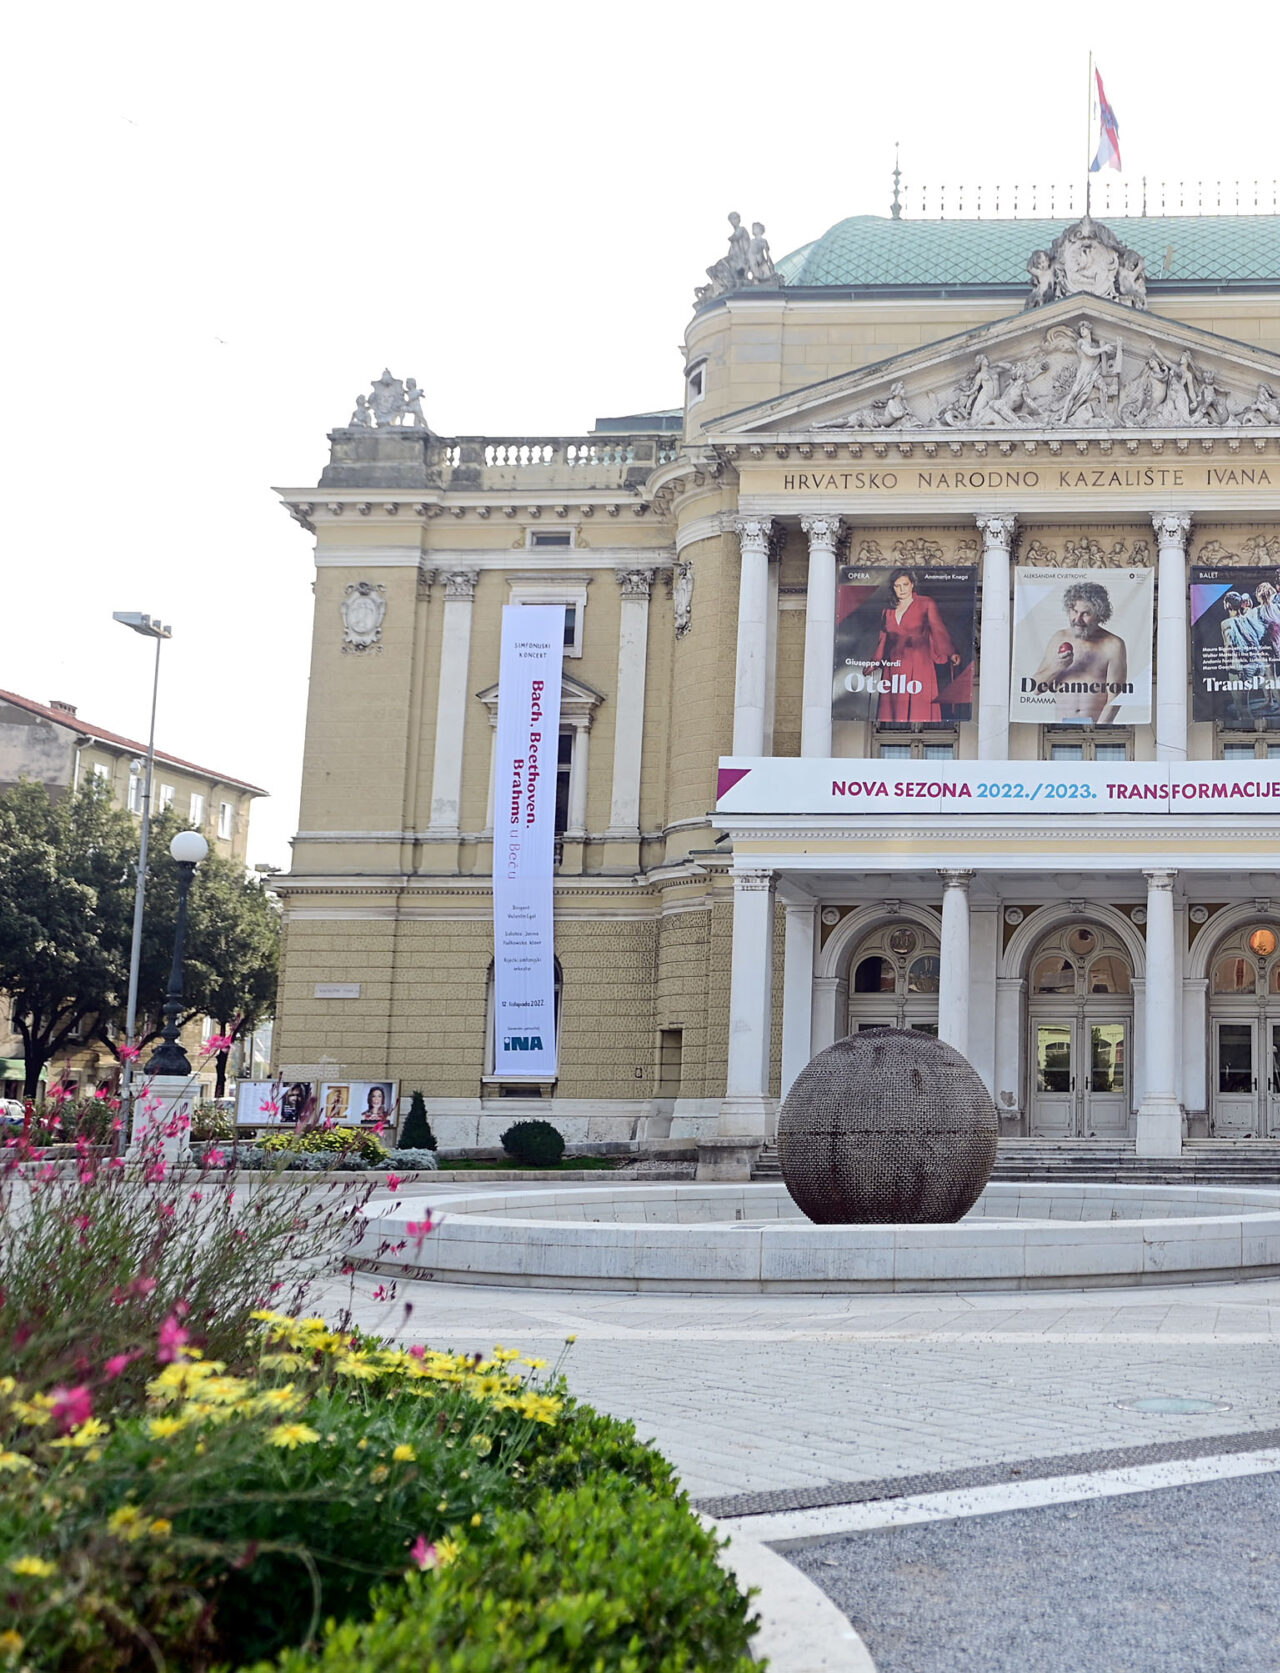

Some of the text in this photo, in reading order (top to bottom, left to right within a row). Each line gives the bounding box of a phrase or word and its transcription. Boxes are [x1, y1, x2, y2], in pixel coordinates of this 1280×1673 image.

[784, 473, 898, 490] HRVATSKO
[918, 471, 1040, 488] NARODNO
[1059, 467, 1184, 487] KAZALIŠTE
[1207, 468, 1272, 486] IVANA
[847, 572, 870, 580] OPERA
[1199, 571, 1219, 579] BALET
[845, 658, 902, 668] Giuseppe Verdi
[844, 672, 923, 695] Otello
[1020, 677, 1135, 694] Decameron
[1019, 696, 1057, 704] DRAMMA
[510, 759, 525, 824] Brahms
[831, 780, 1280, 800] NOVA SEZONA 2022./2023. TRANSFORMACIJE
